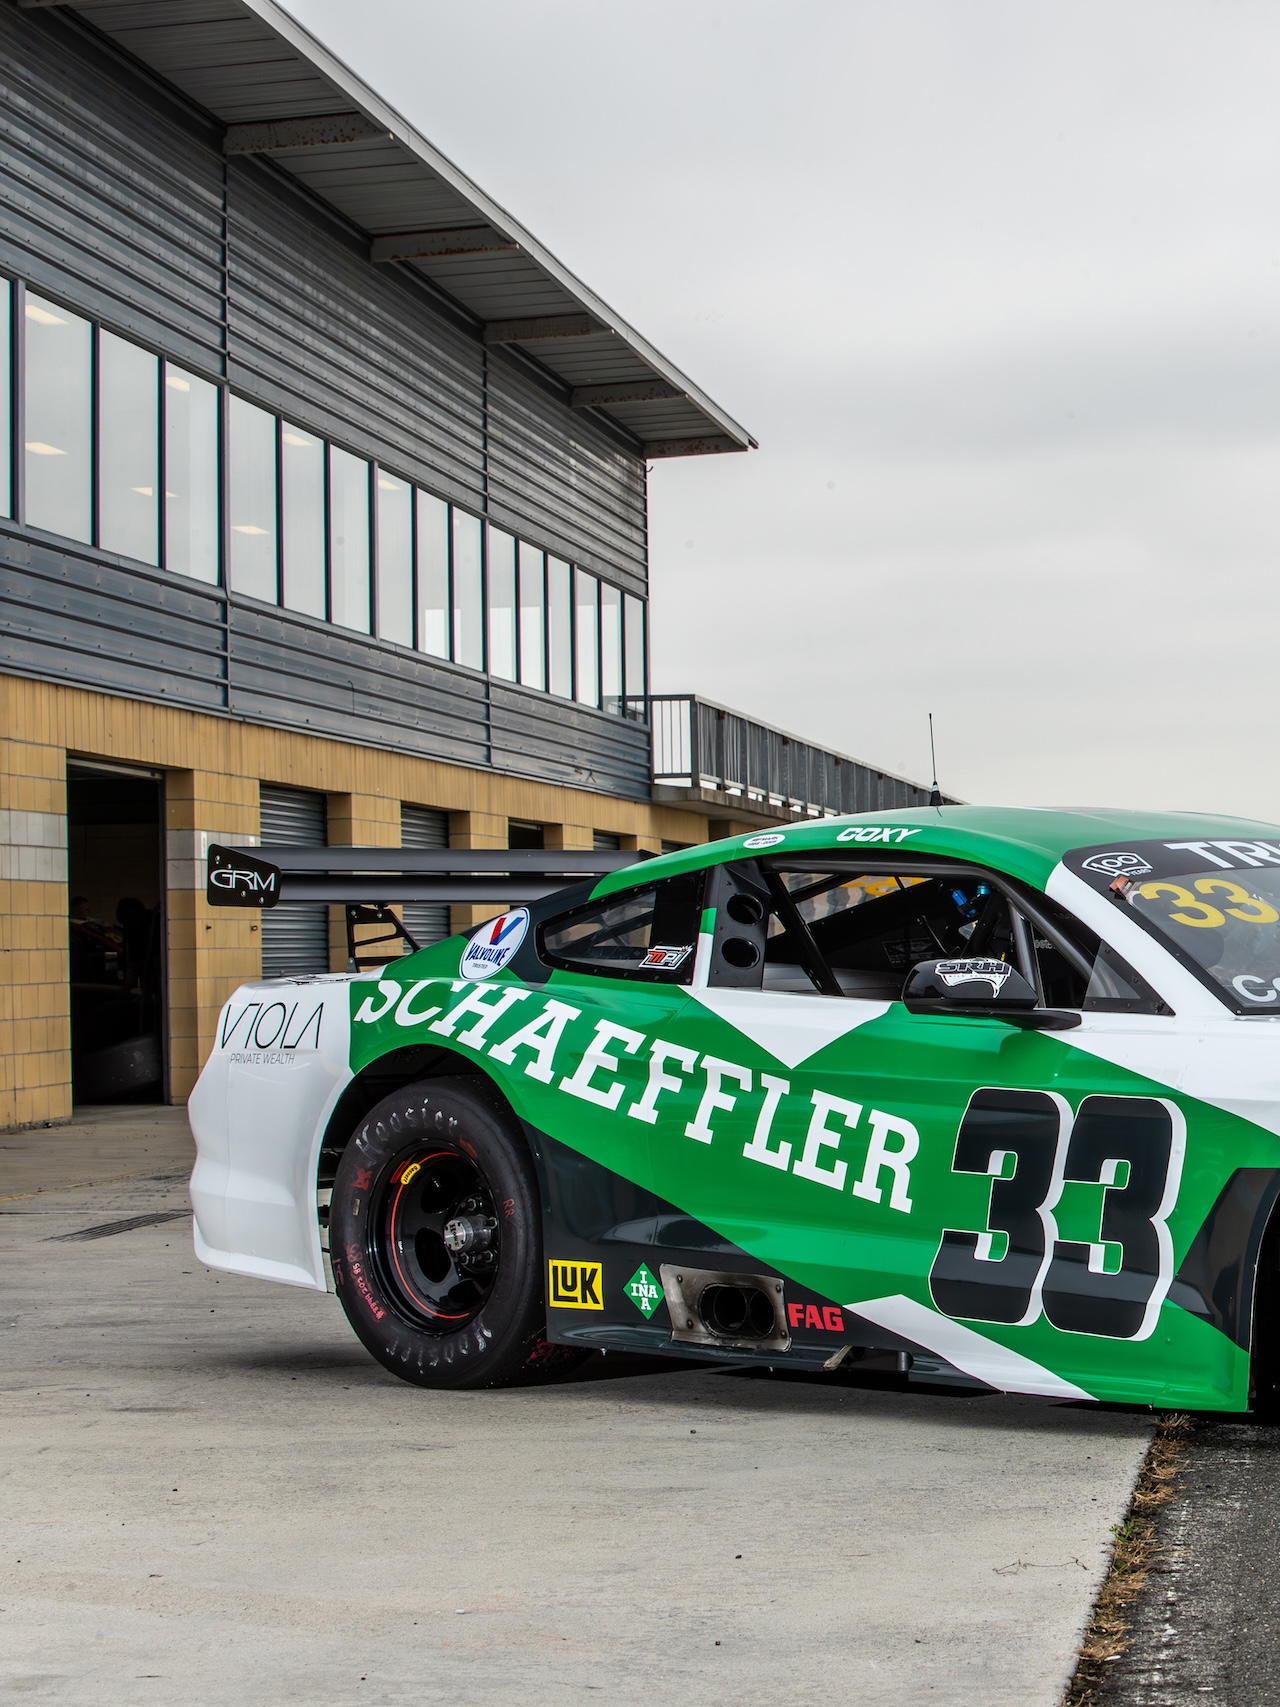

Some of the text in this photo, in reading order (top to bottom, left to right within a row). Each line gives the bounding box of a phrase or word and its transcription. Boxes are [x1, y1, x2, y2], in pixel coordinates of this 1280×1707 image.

[836, 827, 922, 843] COXY
[210, 869, 275, 891] GRM
[1138, 878, 1280, 928] 33
[465, 942, 511, 967] VALVOLINE
[221, 1002, 325, 1049] VIOLA
[230, 1053, 296, 1065] PRIVATE WEALTH
[354, 981, 920, 1214] SCHAEFFLER
[929, 1086, 1188, 1342] 33
[787, 1303, 845, 1332] FAG
